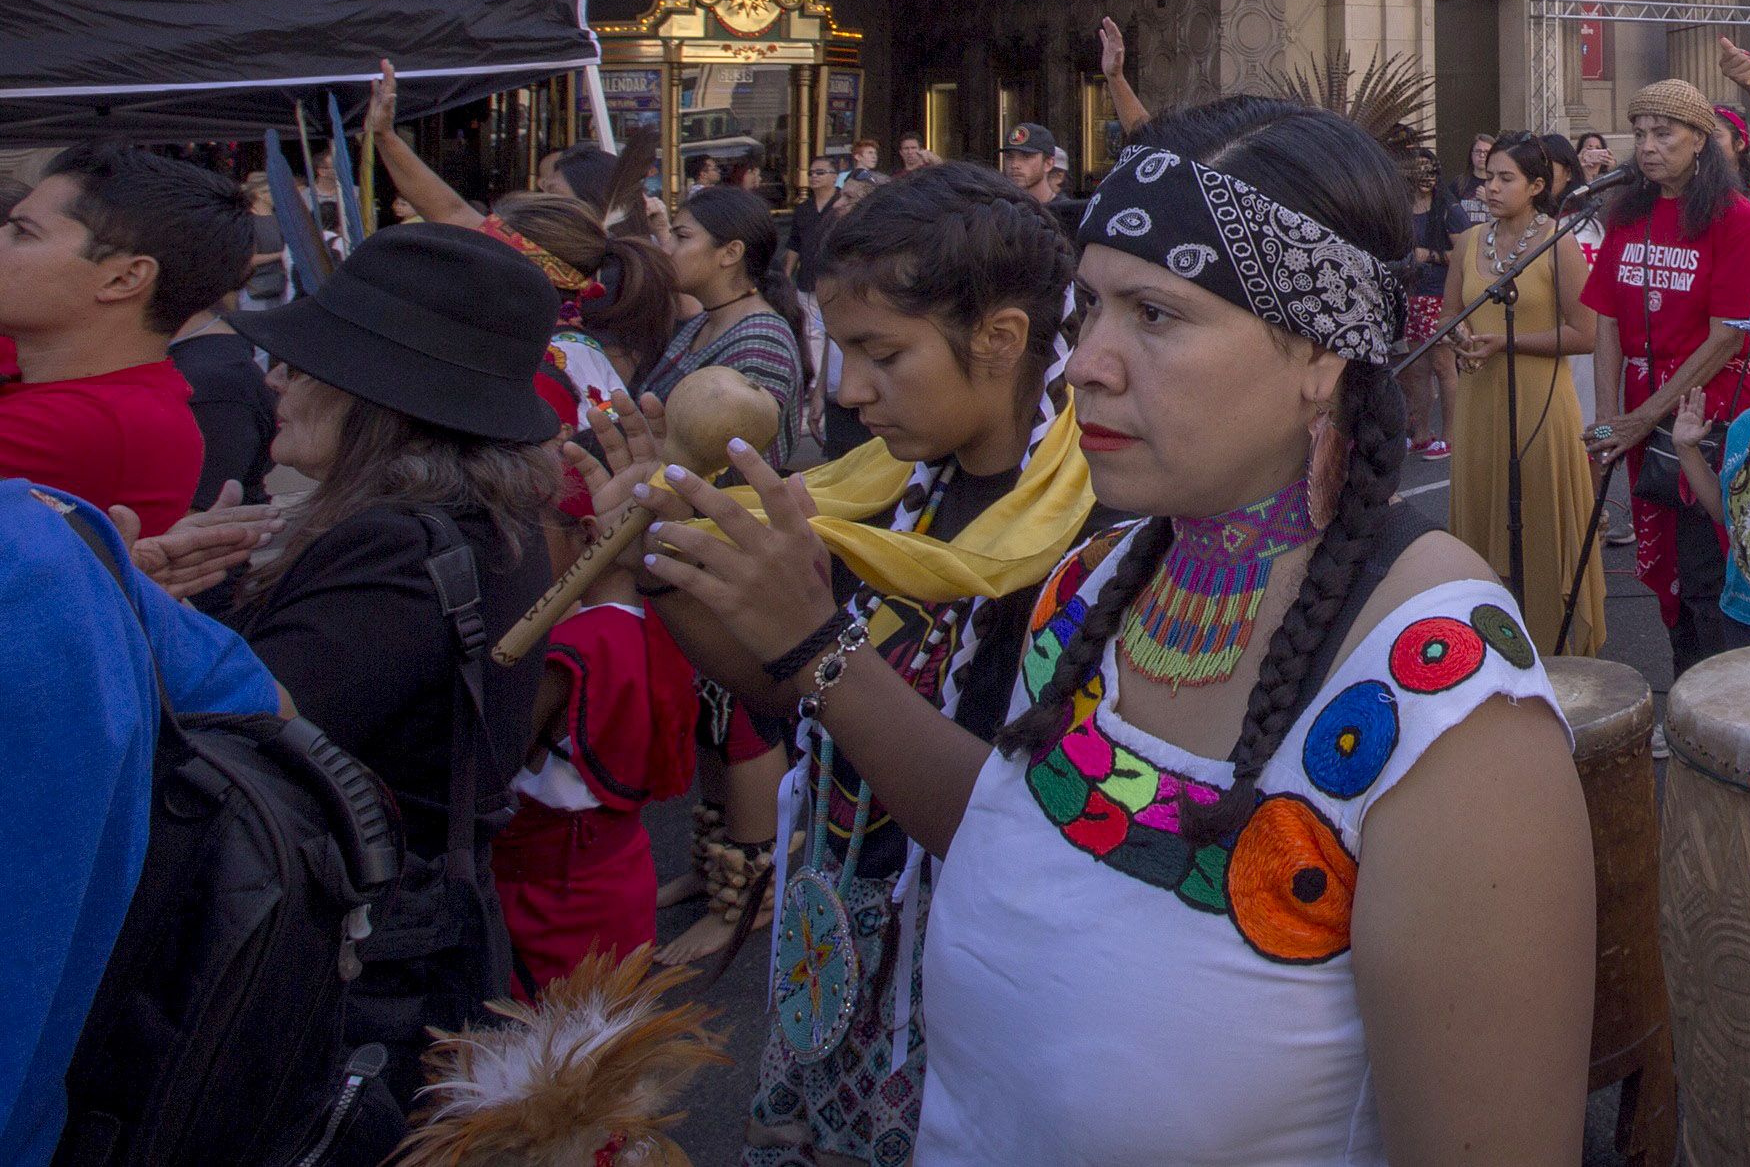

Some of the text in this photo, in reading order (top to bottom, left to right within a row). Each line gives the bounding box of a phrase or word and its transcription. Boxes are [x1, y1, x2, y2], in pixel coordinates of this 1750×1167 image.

[1621, 240, 1699, 271] INDGENOUS
[1617, 264, 1695, 292] PELES DAY
